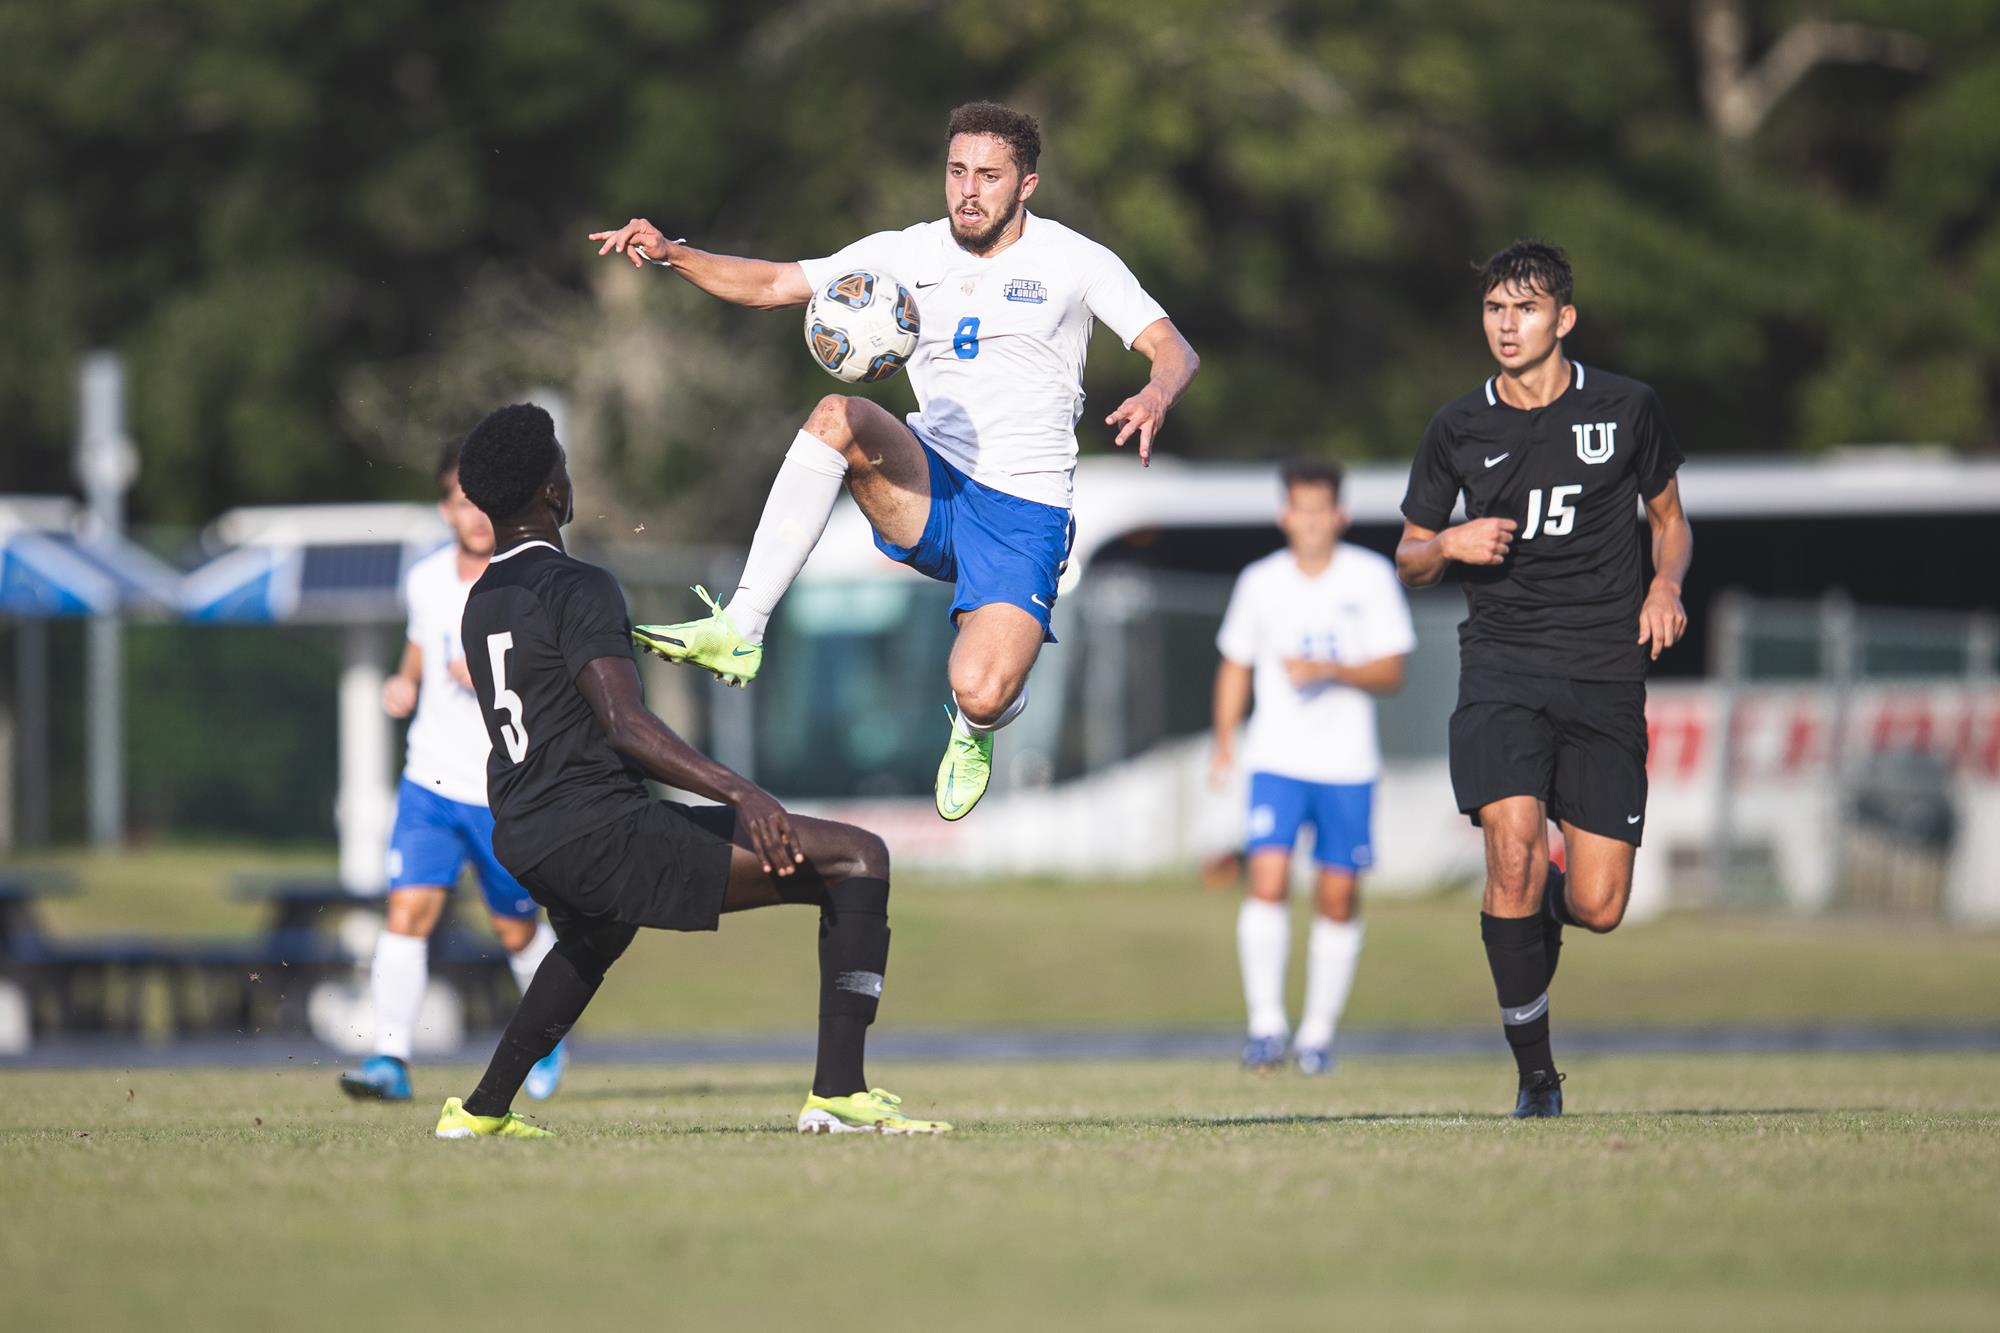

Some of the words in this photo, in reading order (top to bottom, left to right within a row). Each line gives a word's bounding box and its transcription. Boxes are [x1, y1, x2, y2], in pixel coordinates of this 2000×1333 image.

[1004, 284, 1047, 301] FLORIDA
[1012, 279, 1041, 290] WEST
[953, 316, 980, 359] 8
[1572, 422, 1617, 465] U
[1521, 484, 1582, 540] 15
[487, 631, 529, 764] 5
